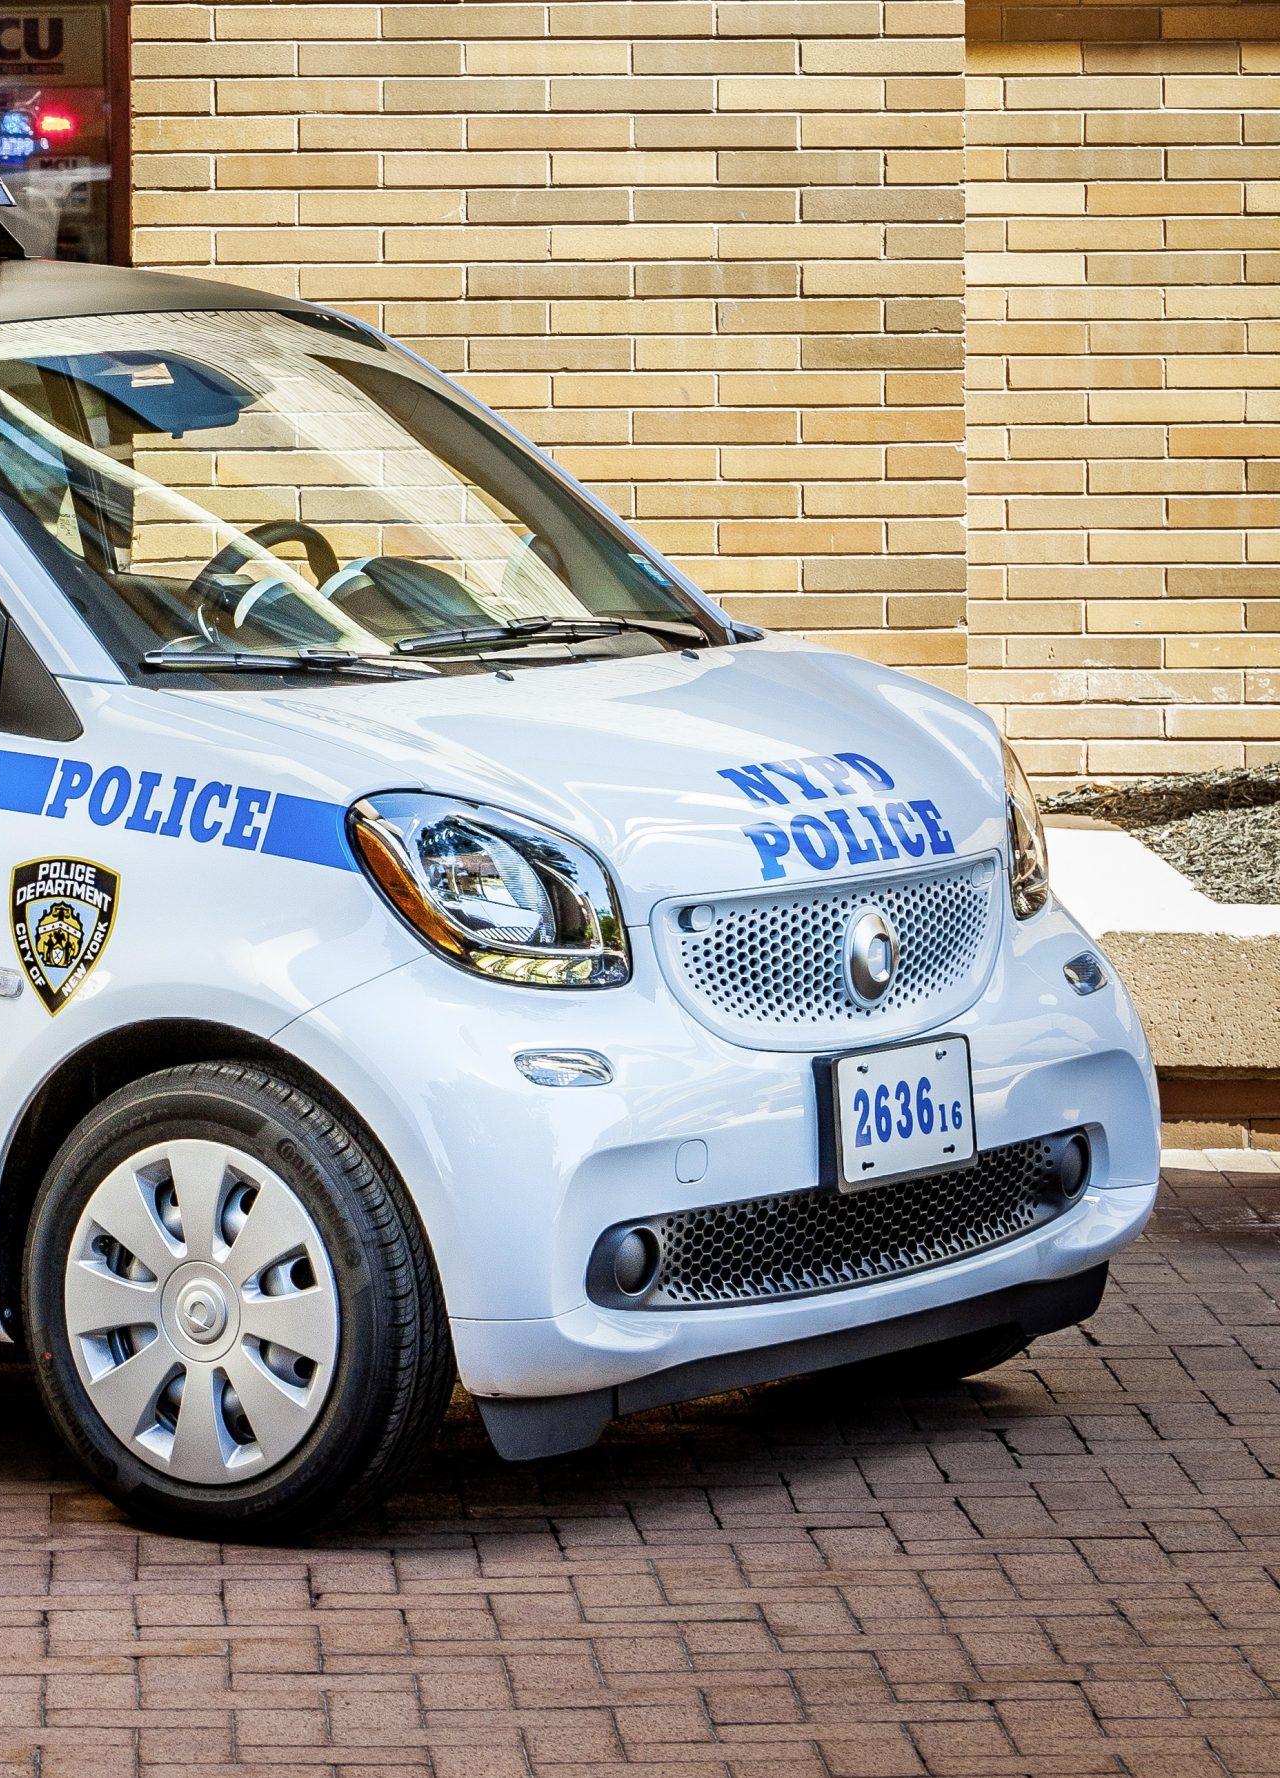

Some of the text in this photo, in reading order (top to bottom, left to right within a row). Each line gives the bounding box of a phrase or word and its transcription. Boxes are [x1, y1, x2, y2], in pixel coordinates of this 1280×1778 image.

[46, 759, 271, 851] POLICE
[716, 752, 895, 809] NYPD
[741, 799, 955, 881] POLICE
[16, 881, 112, 912] DEPARTMENT
[38, 862, 97, 885] POLICE
[15, 921, 109, 997] CITY OF NEW YORK
